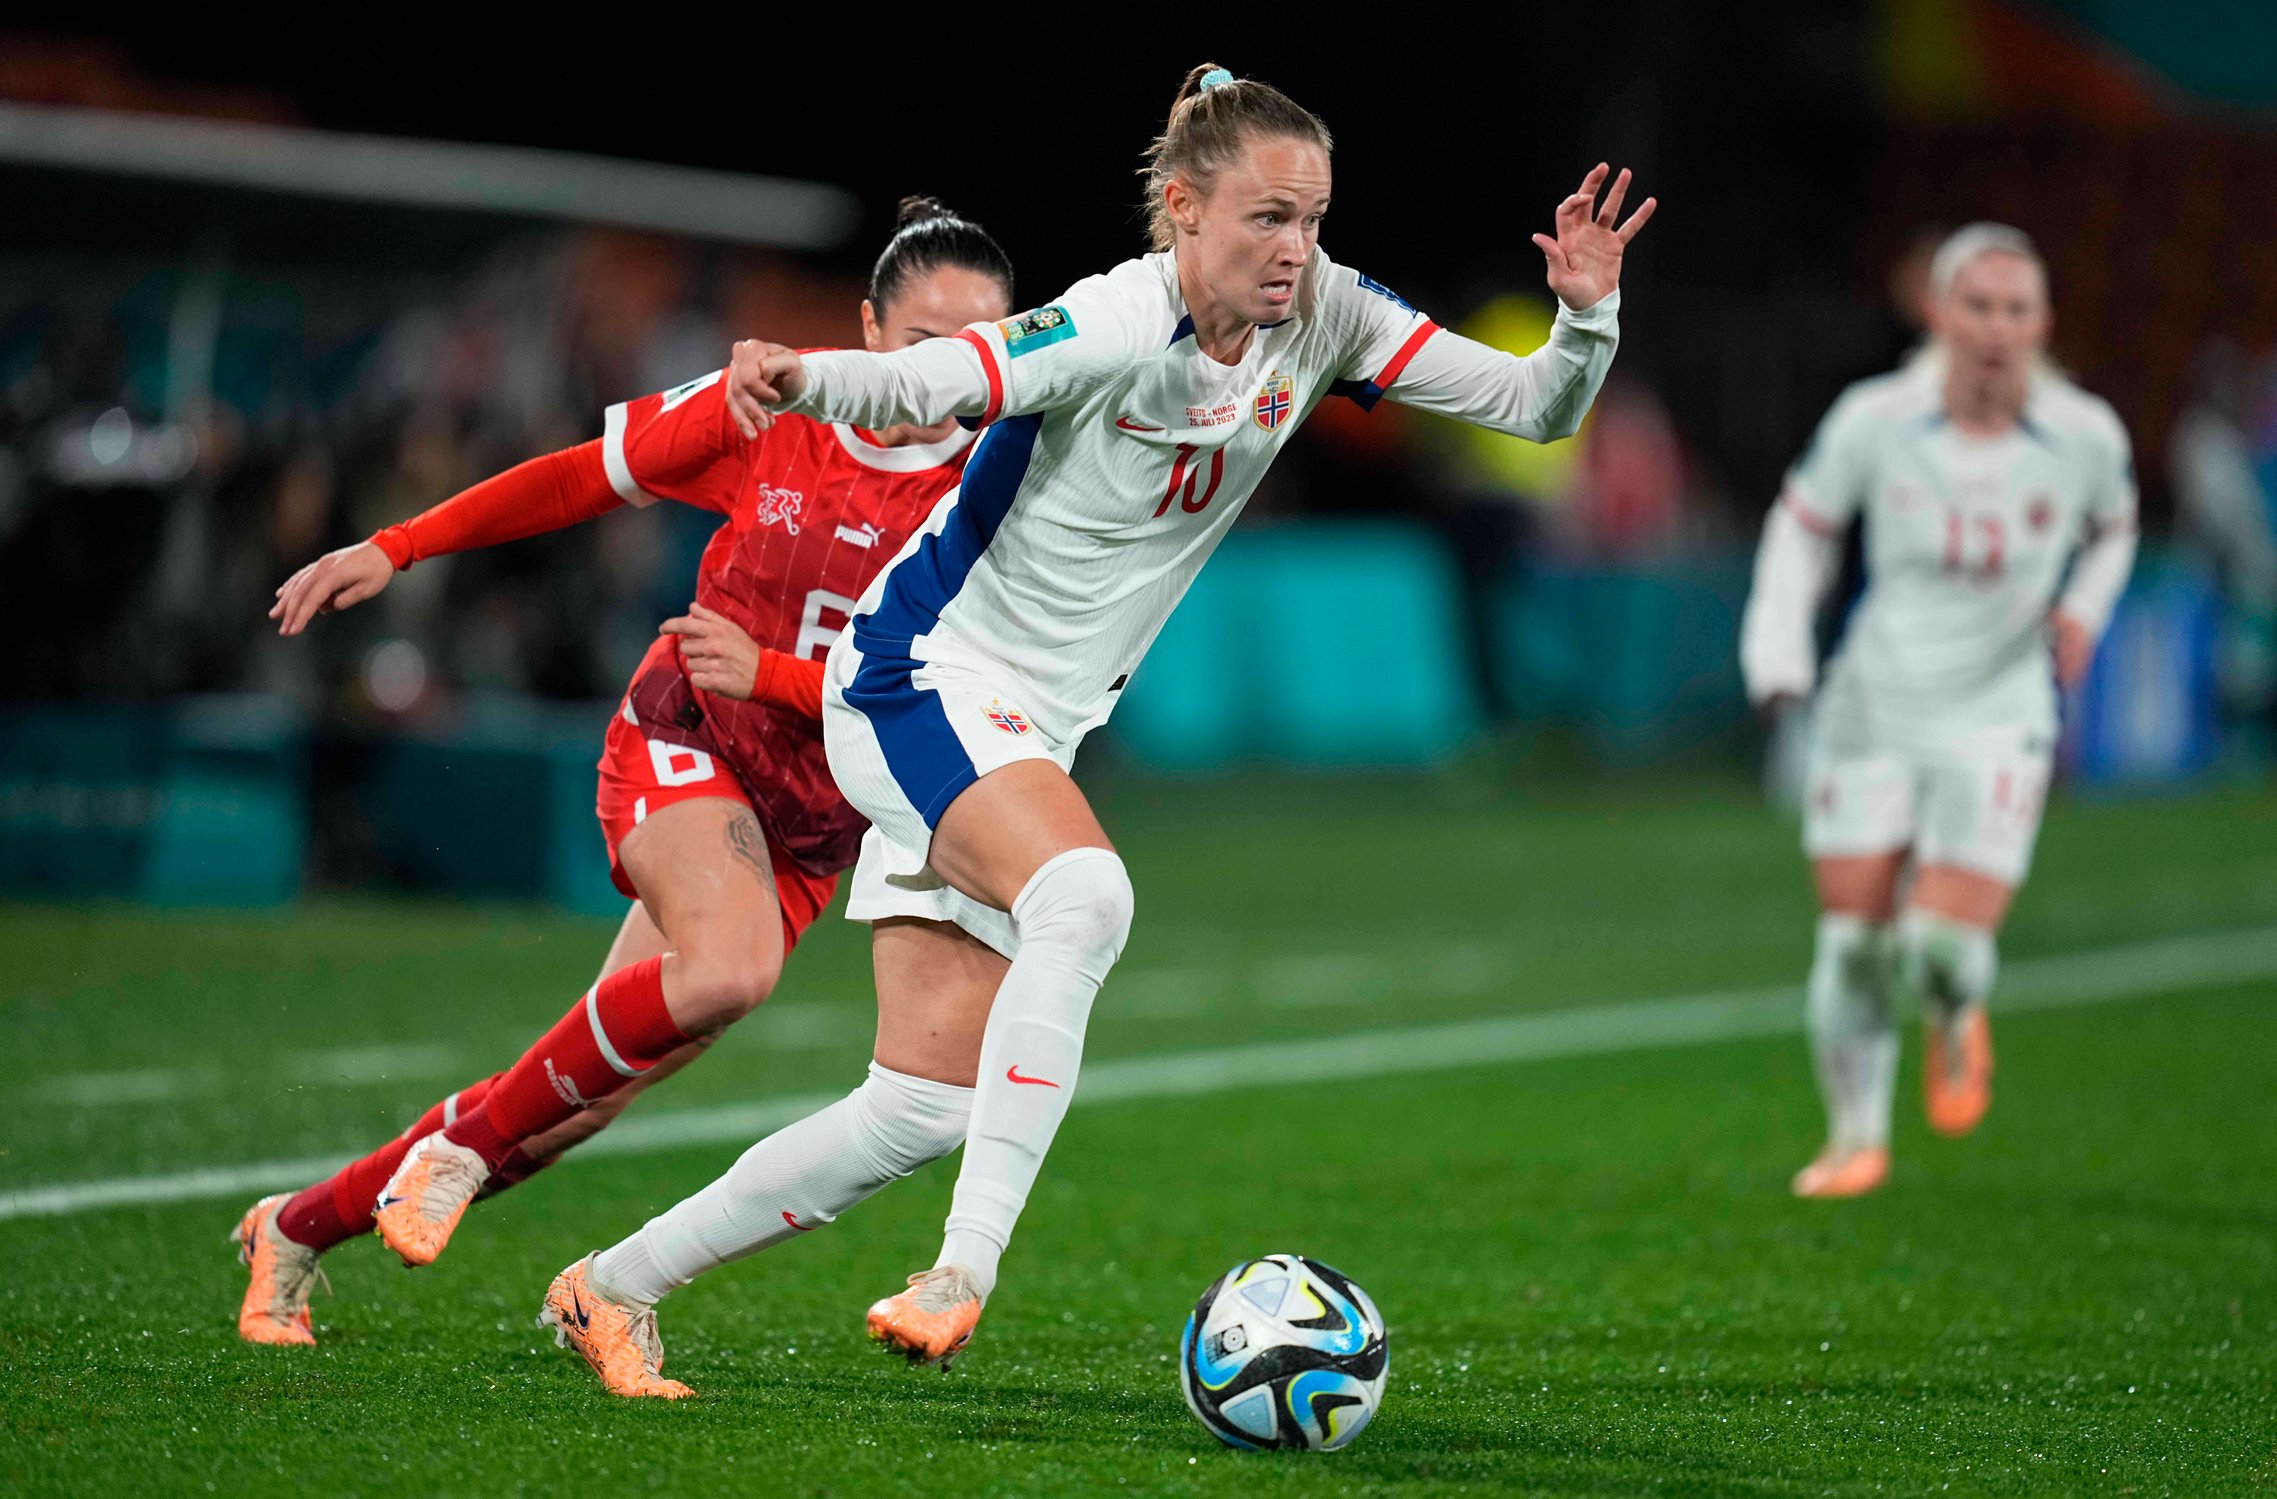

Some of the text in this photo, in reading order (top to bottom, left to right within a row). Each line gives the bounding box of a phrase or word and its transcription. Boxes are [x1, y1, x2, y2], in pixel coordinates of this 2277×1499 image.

[1186, 408, 1206, 417] SVEITS
[1212, 403, 1237, 416] NORGE
[1189, 413, 1236, 427] 25. JULI 2023
[1152, 442, 1225, 518] 10
[647, 739, 716, 787] 6
